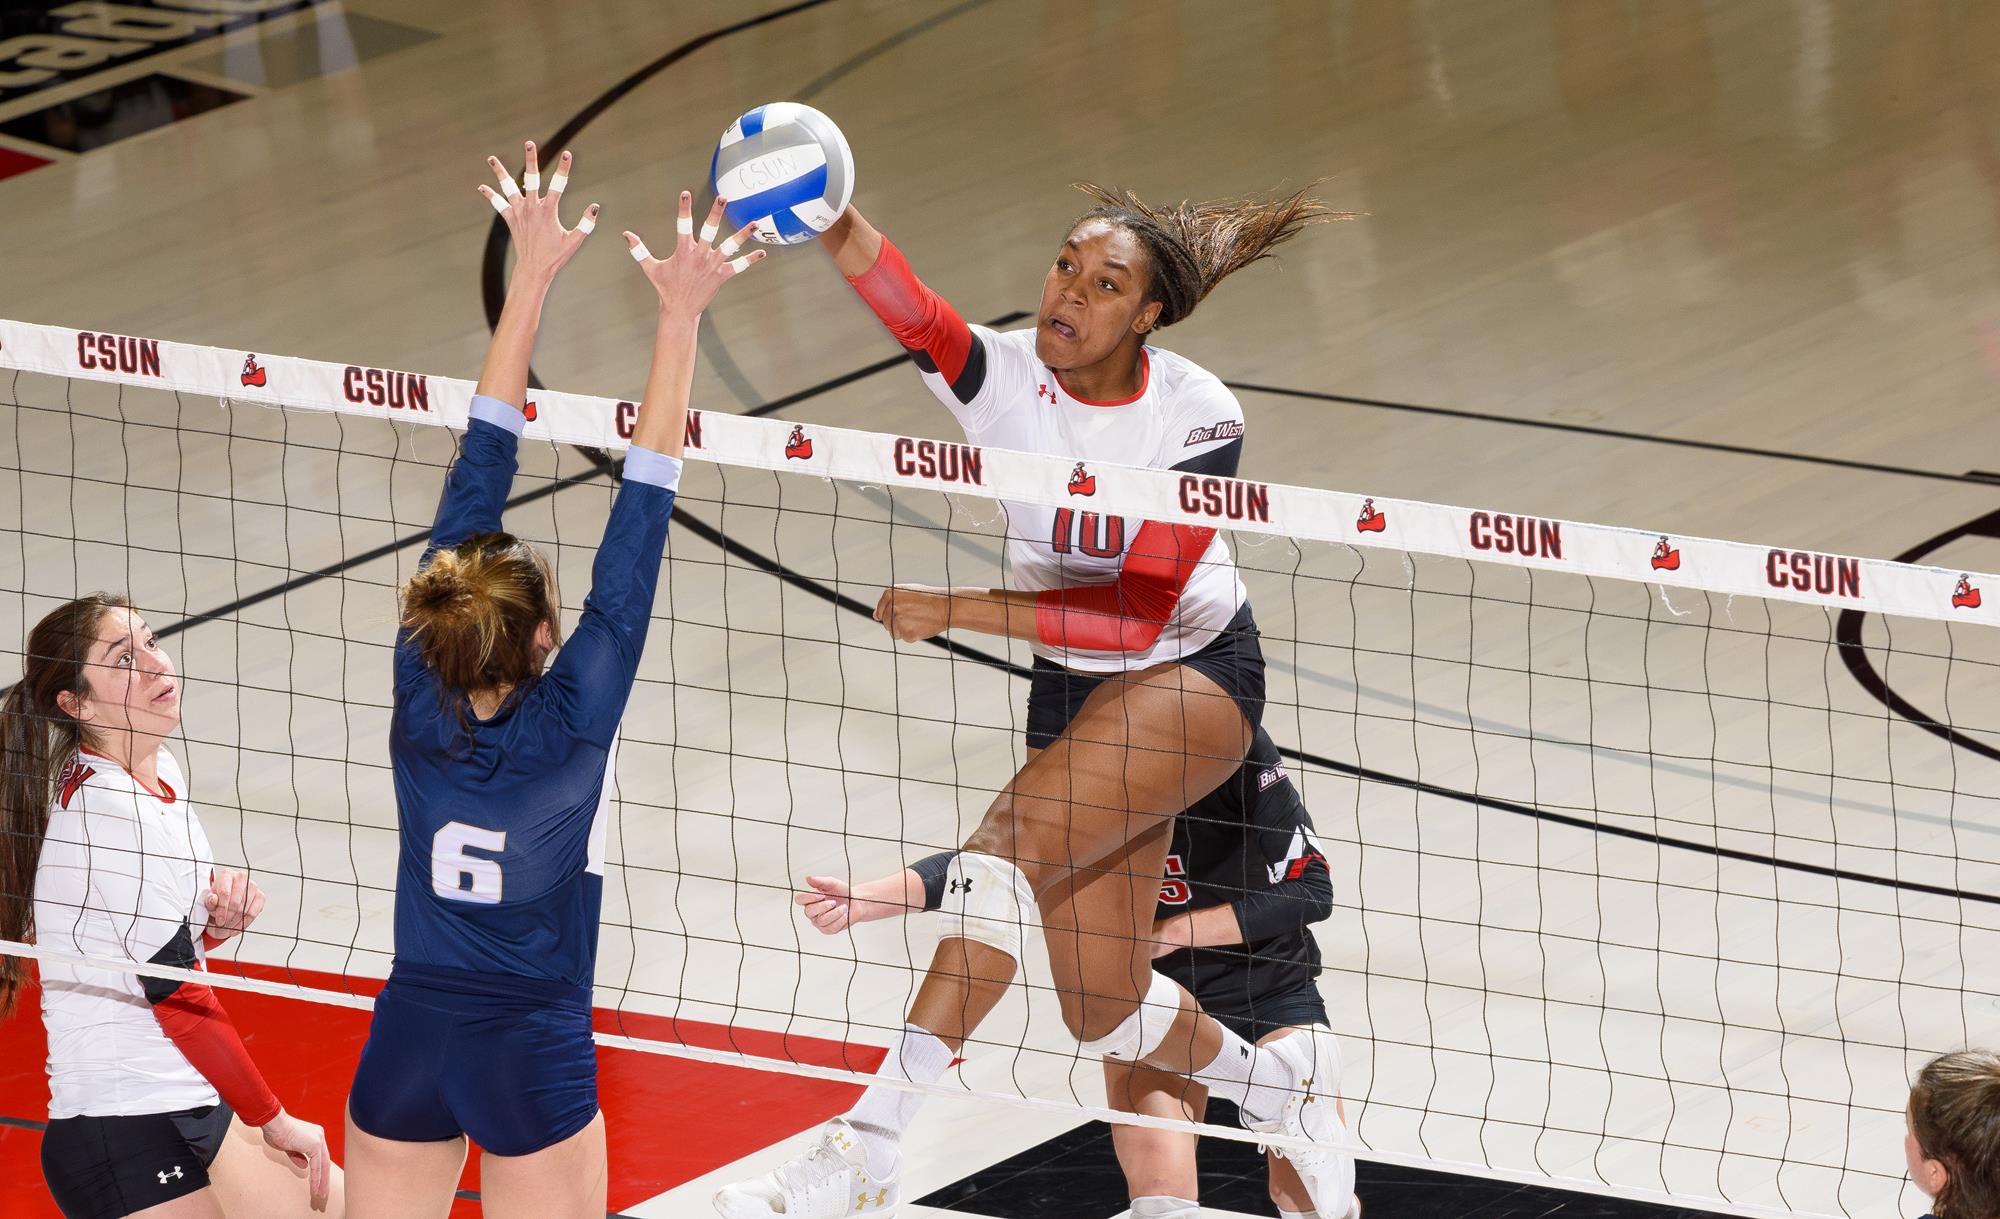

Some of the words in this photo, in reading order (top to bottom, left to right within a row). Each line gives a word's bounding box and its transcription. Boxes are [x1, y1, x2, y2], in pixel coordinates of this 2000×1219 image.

[738, 153, 799, 191] CSUN
[77, 332, 161, 378] CSUN
[343, 367, 429, 412] CSUN
[615, 401, 702, 449] CN
[894, 437, 982, 486] CSUN
[1178, 475, 1270, 523] CSUN
[1469, 511, 1562, 560] CSUN
[1766, 549, 1860, 598] CSUN
[431, 820, 507, 905] 6
